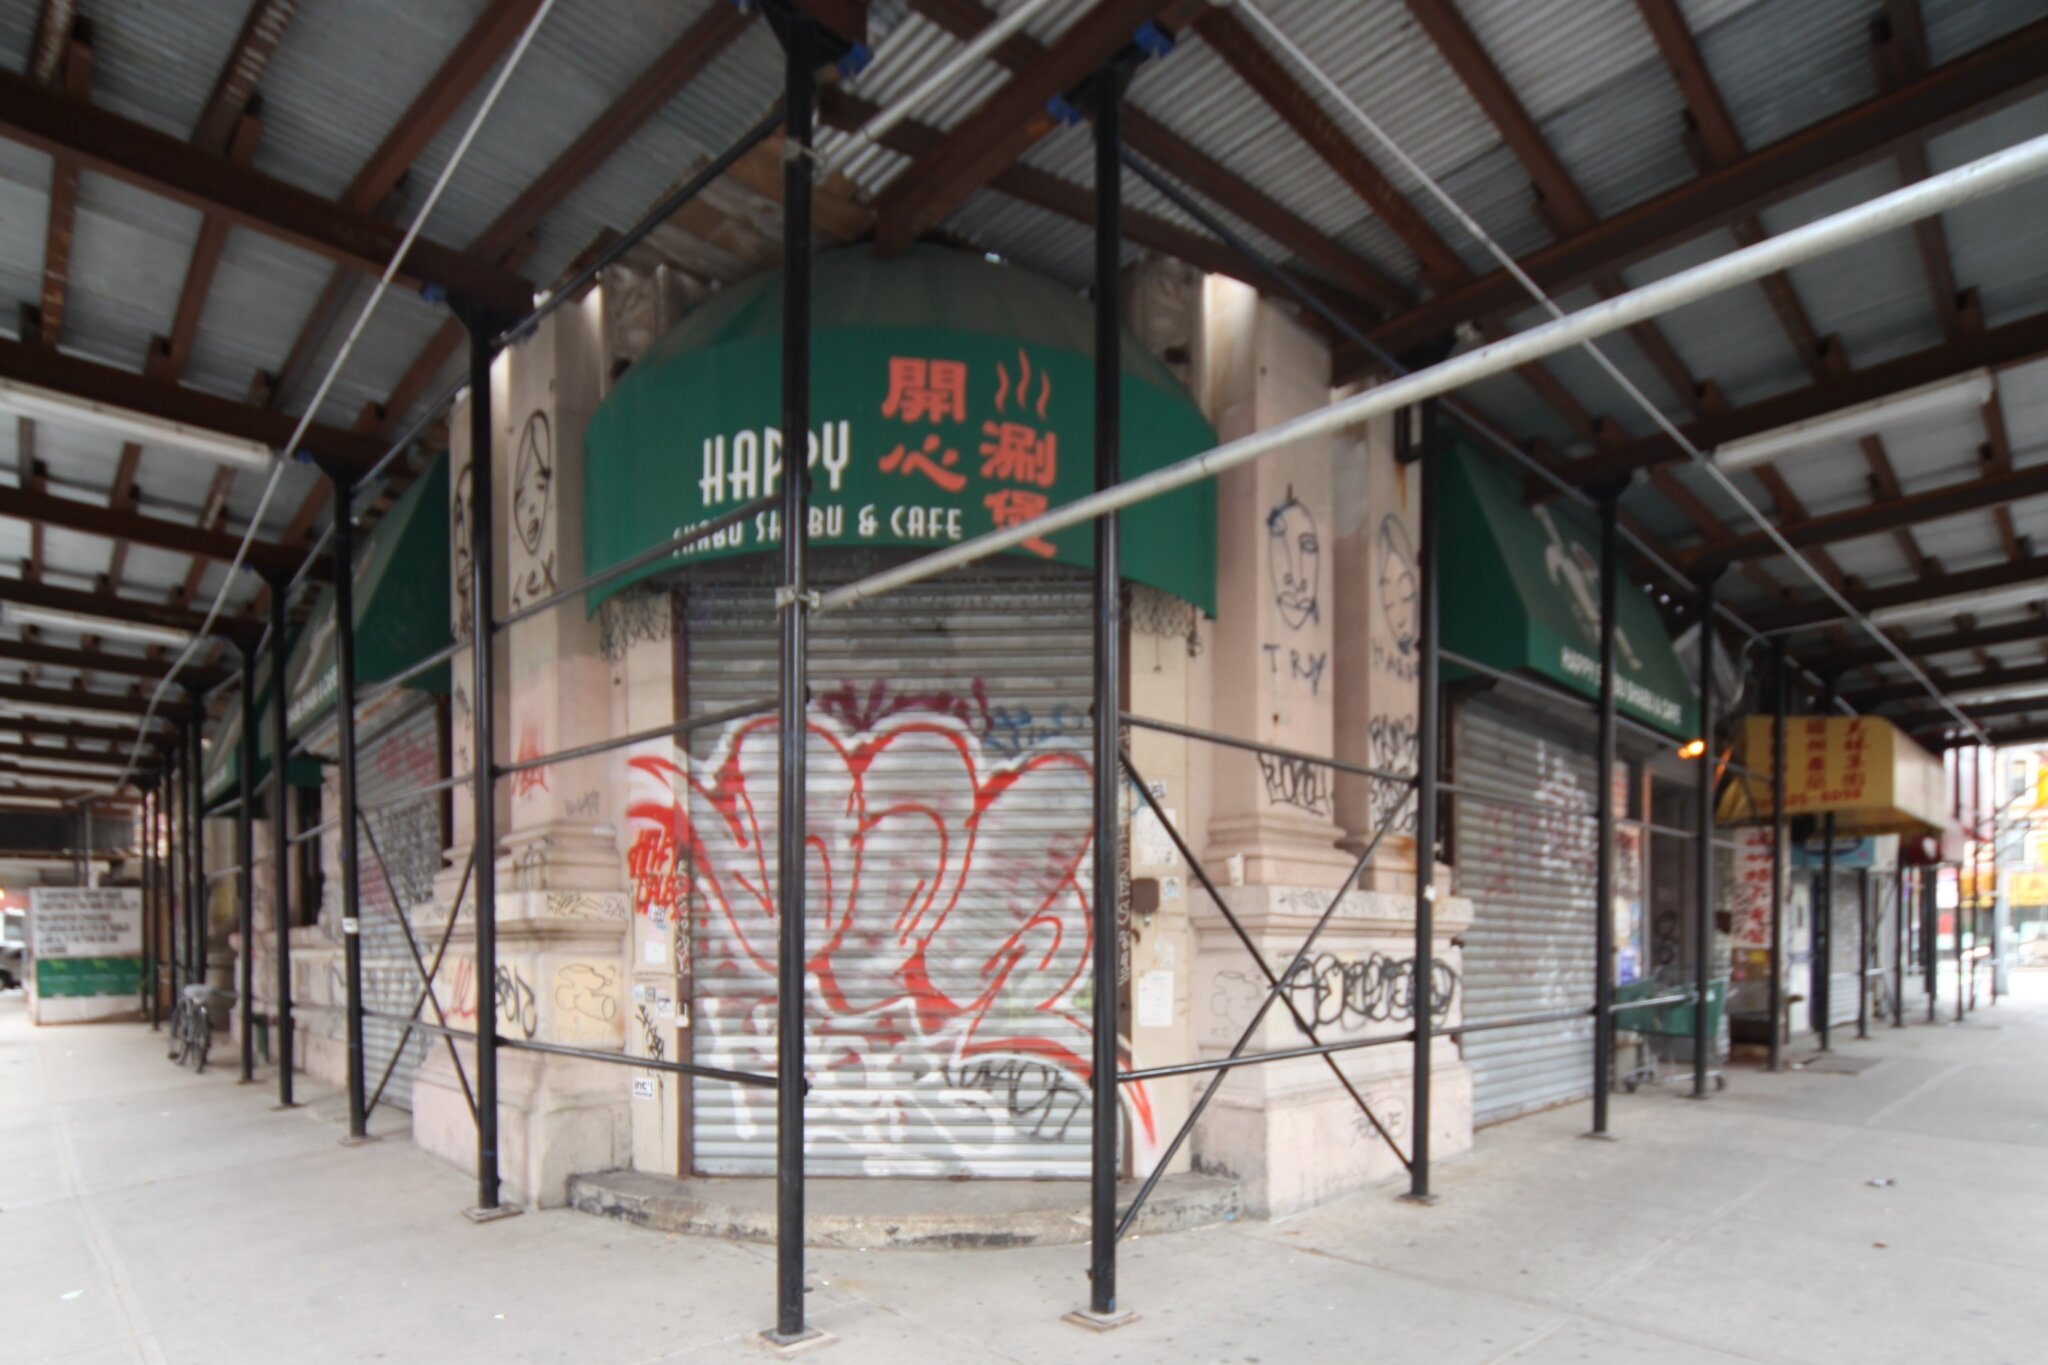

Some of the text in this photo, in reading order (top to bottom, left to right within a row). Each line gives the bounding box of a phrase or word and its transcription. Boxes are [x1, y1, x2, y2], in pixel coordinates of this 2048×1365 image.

[879, 356, 967, 491] 開心
[755, 504, 842, 543] SHBU
[858, 503, 879, 537] &
[890, 505, 963, 541] CAFE
